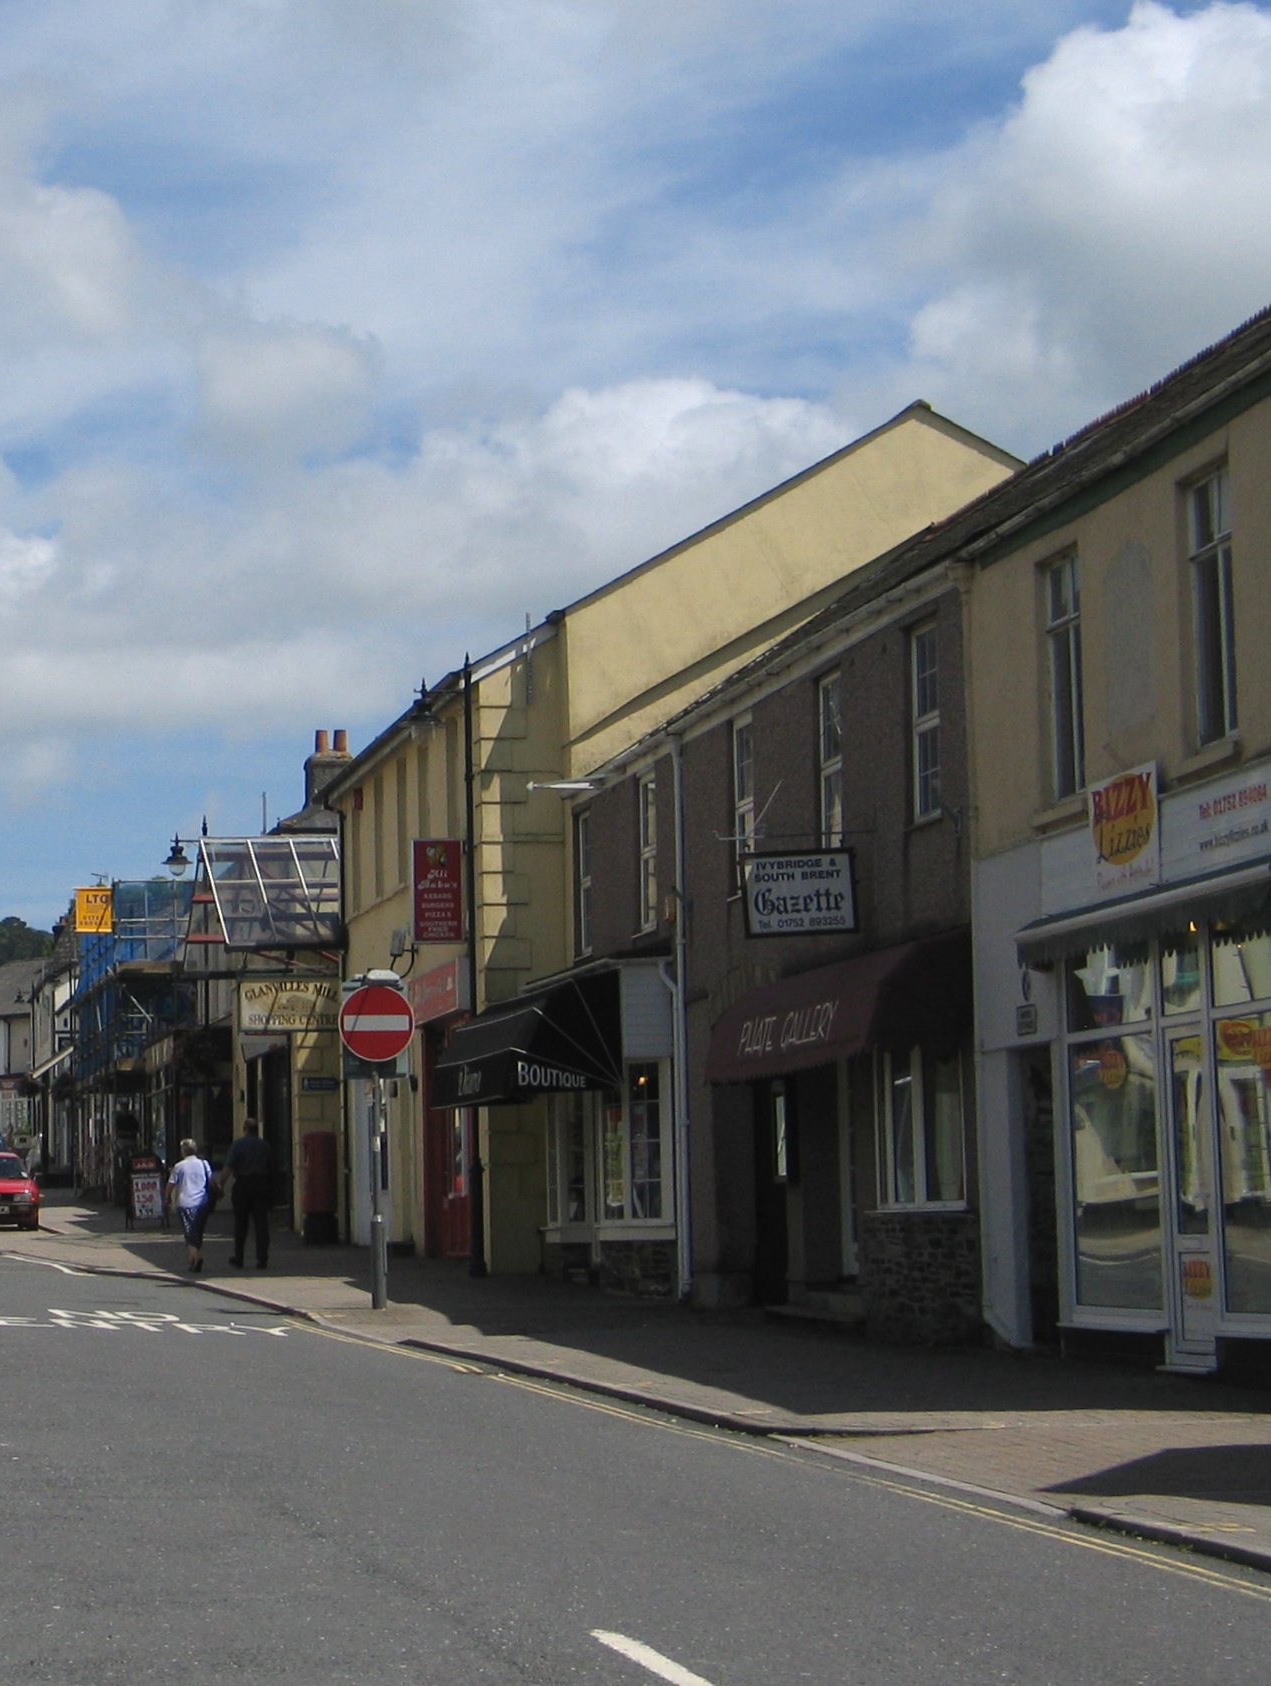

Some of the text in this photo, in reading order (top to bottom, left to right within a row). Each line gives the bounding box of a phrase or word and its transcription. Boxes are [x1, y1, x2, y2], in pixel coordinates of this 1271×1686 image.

[1091, 772, 1152, 827] BIZZY
[756, 858, 837, 871] IVYBRIDGE &
[427, 869, 447, 879] Ali
[754, 869, 841, 883] SOUTH BRENT
[754, 887, 845, 917] Gazette
[777, 918, 805, 928] 01752
[244, 982, 310, 1001] GLANVILLES
[249, 1013, 296, 1025] SHOPPING
[780, 1000, 839, 1052] GALLERY
[517, 1060, 587, 1088] BOUTIQUE
[47, 1308, 181, 1322] NO
